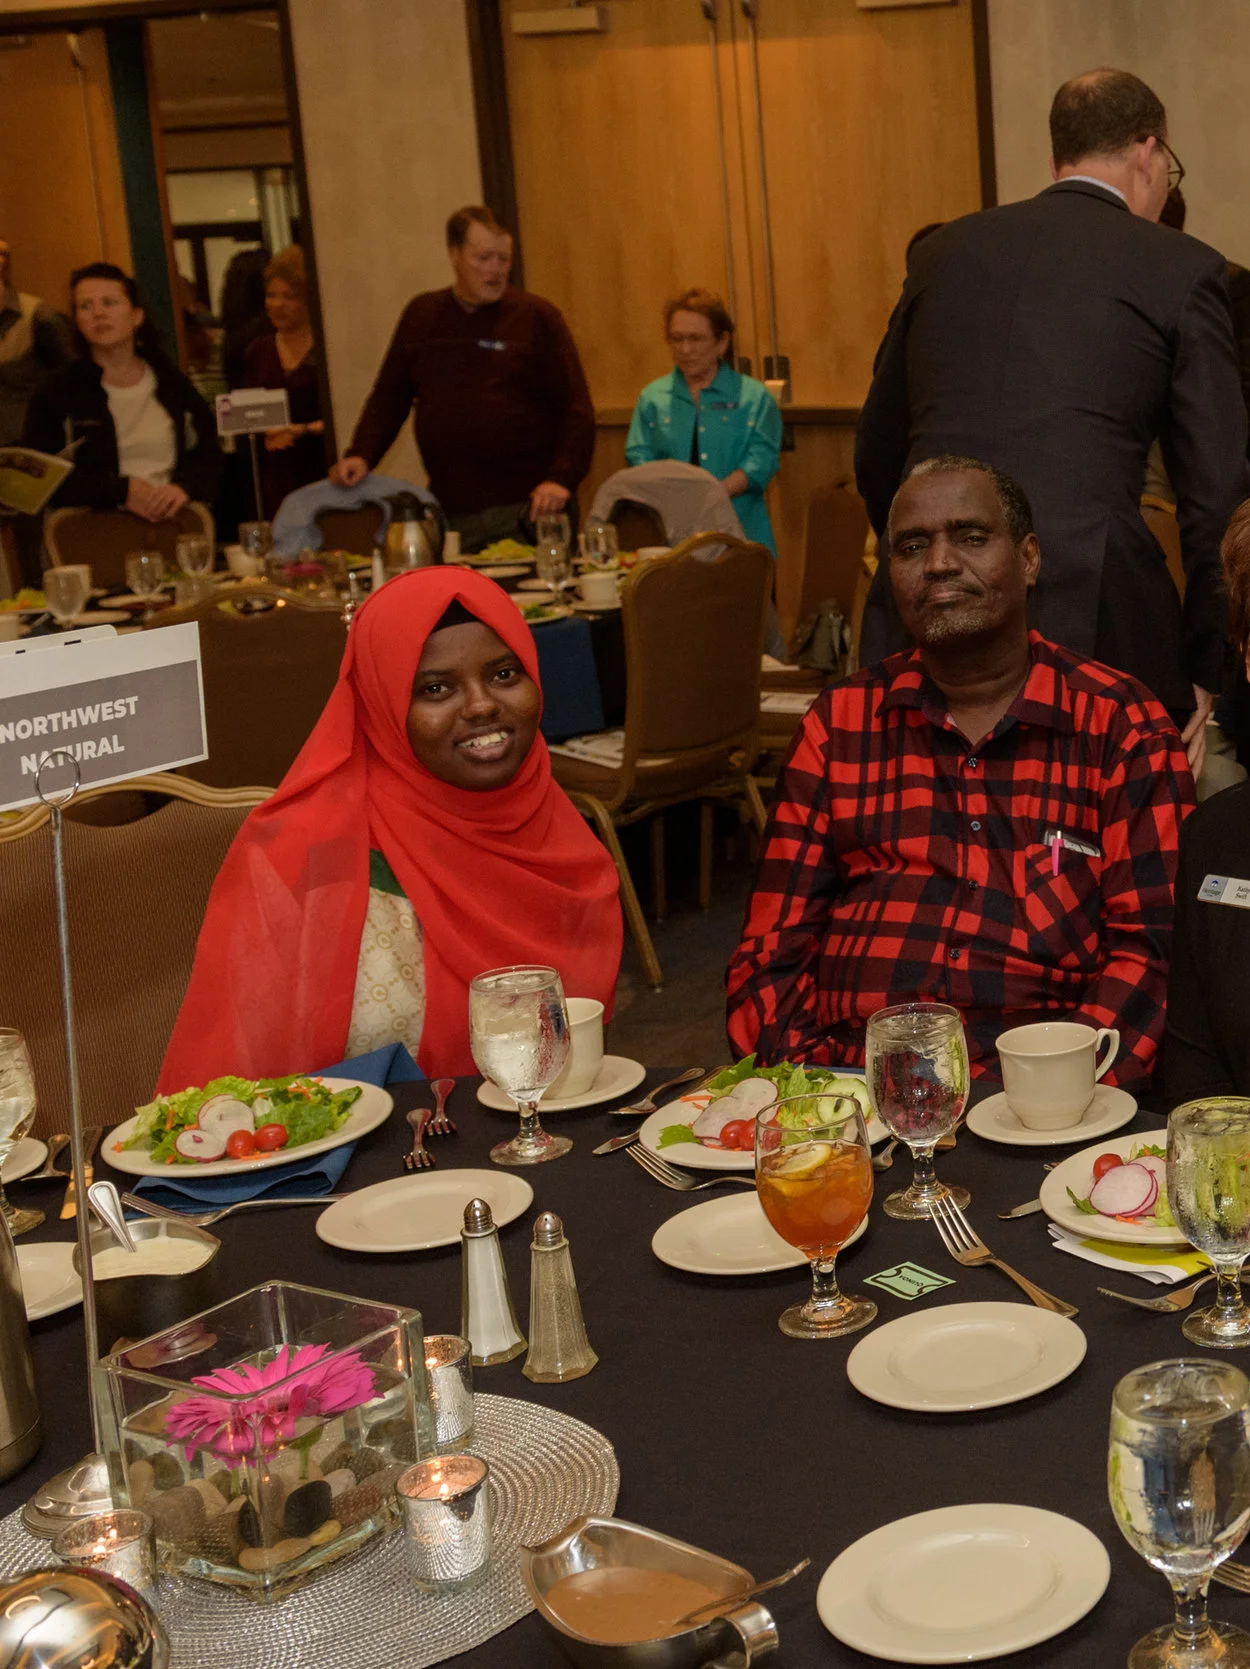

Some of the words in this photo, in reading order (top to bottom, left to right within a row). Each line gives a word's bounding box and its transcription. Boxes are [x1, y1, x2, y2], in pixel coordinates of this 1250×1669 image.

[0, 696, 139, 744] NORTHWEST
[20, 735, 125, 775] NATURAL
[898, 1275, 924, 1287] QUINOA
